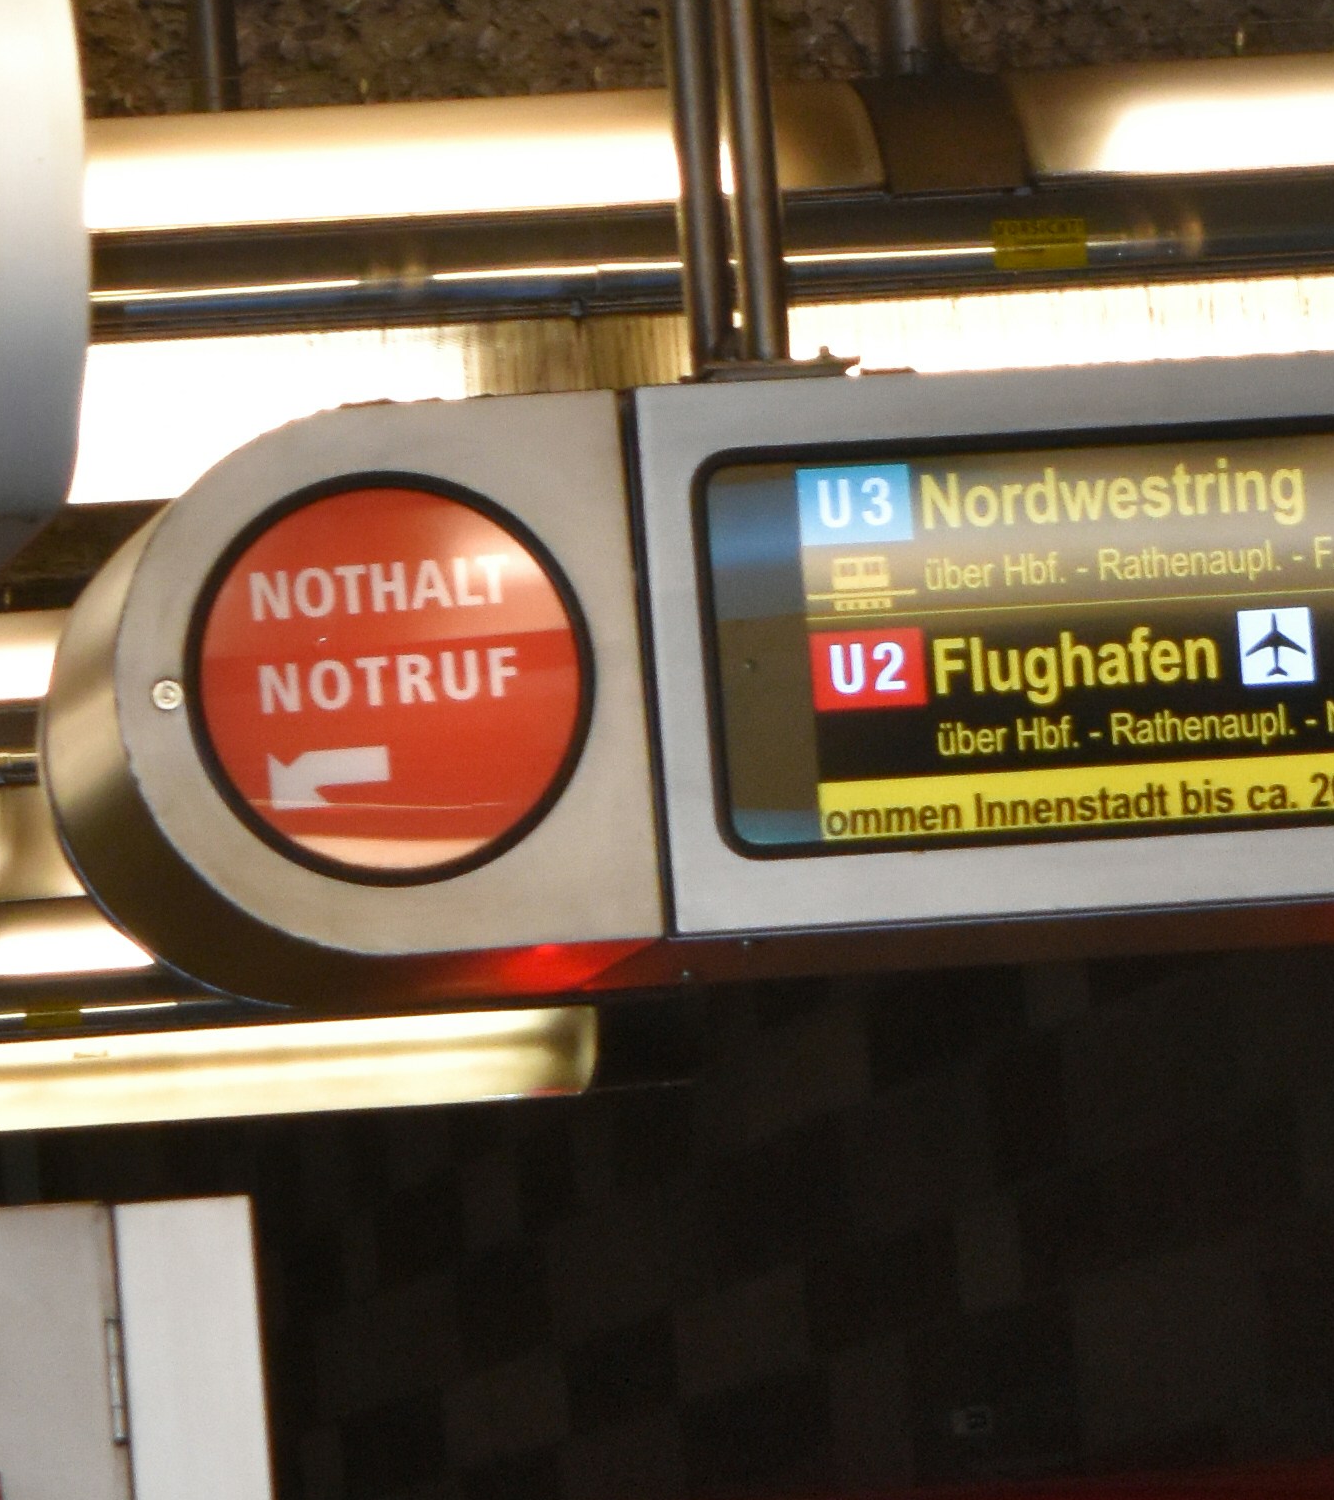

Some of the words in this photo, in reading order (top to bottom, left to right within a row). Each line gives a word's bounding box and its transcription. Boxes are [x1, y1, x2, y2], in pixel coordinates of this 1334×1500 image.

[816, 476, 895, 528] U3
[919, 458, 1306, 526] Nordwestring
[249, 556, 508, 621] NOTHALT
[924, 555, 994, 592] über
[1005, 551, 1066, 586] Hbf.
[1098, 539, 1282, 582] Rathenaupl.
[257, 647, 518, 714] NOTRUF
[828, 641, 908, 695] U2
[932, 626, 1221, 704] Flughafen
[937, 722, 1007, 757] über
[1016, 715, 1080, 751] Hbf.
[1110, 705, 1295, 746] Rathenaupl.
[826, 802, 963, 837] ommen
[973, 783, 1169, 828] Innenstadt
[1179, 778, 1234, 817] bis
[1246, 782, 1298, 813] ca.
